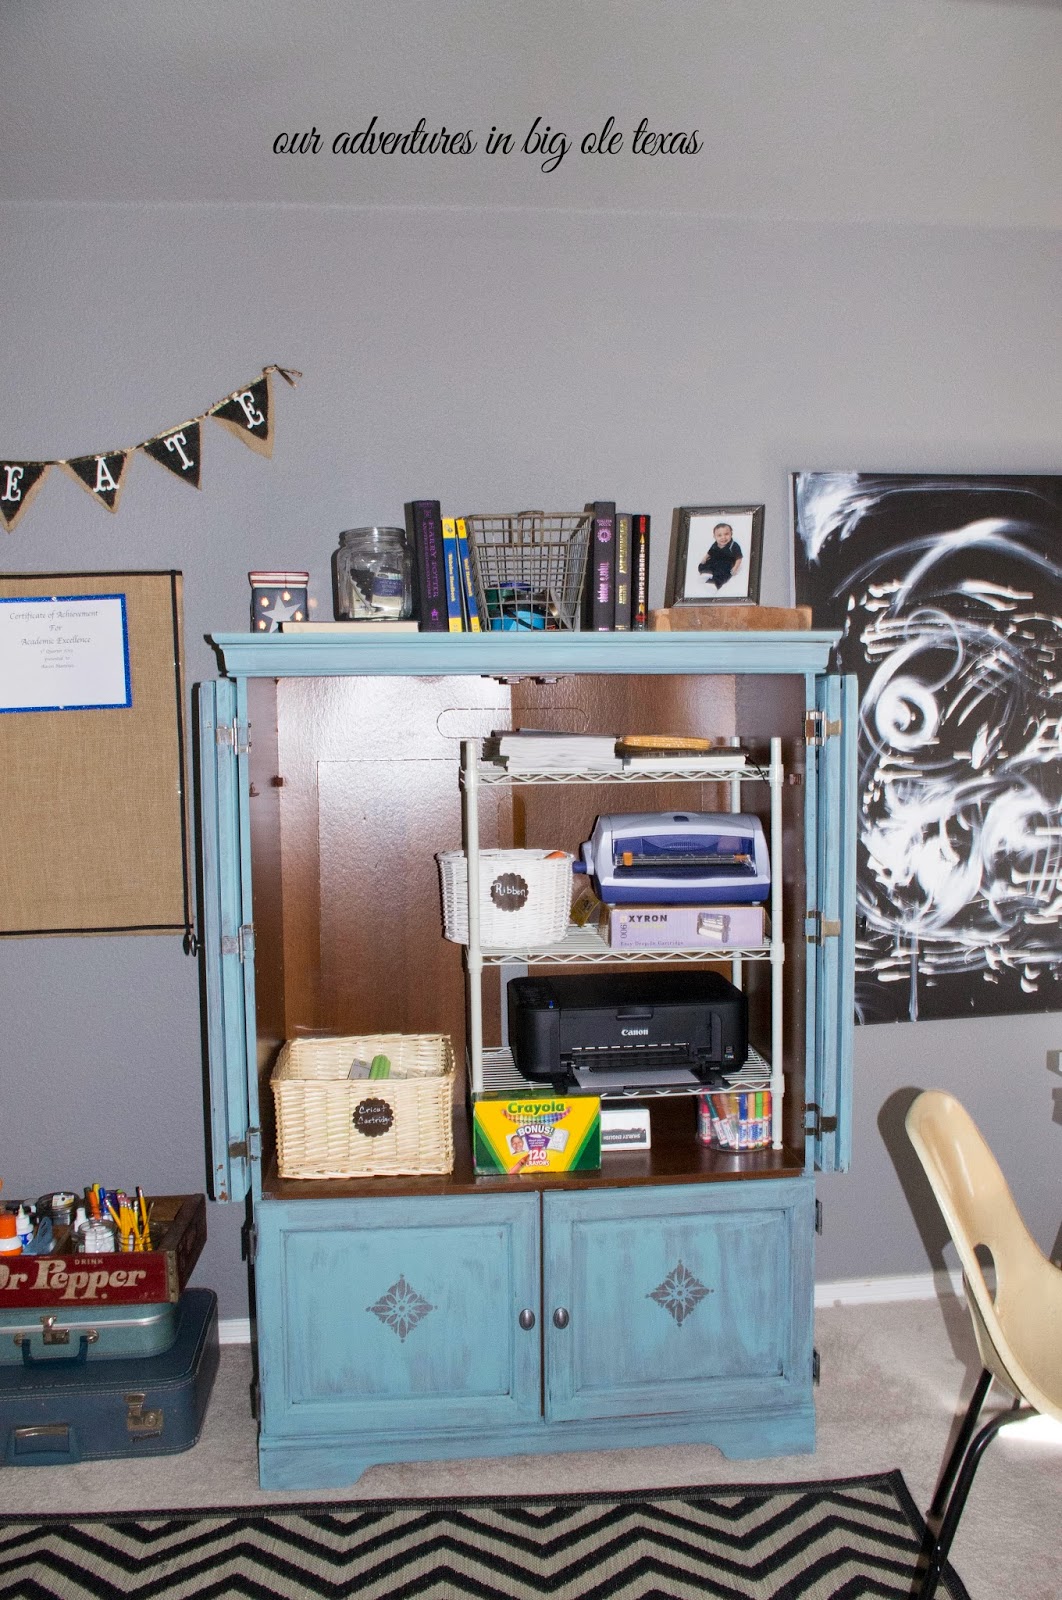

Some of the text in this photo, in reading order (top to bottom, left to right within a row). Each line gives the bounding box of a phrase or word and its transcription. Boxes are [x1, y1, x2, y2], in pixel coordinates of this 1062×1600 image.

[428, 521, 439, 598] HARRY POTTER
[9, 609, 98, 622] Certificate of Achievement
[49, 624, 62, 632] For
[21, 635, 91, 647] Academic Excellence
[493, 882, 528, 898] Ribbon
[628, 914, 668, 922] XYRON
[621, 1028, 649, 1036] Canon
[359, 1105, 388, 1114] Cricut
[507, 1101, 565, 1115] Crayola
[517, 1125, 554, 1137] BONUS!
[528, 1149, 547, 1160] 120
[29, 1259, 147, 1300] Pepper
